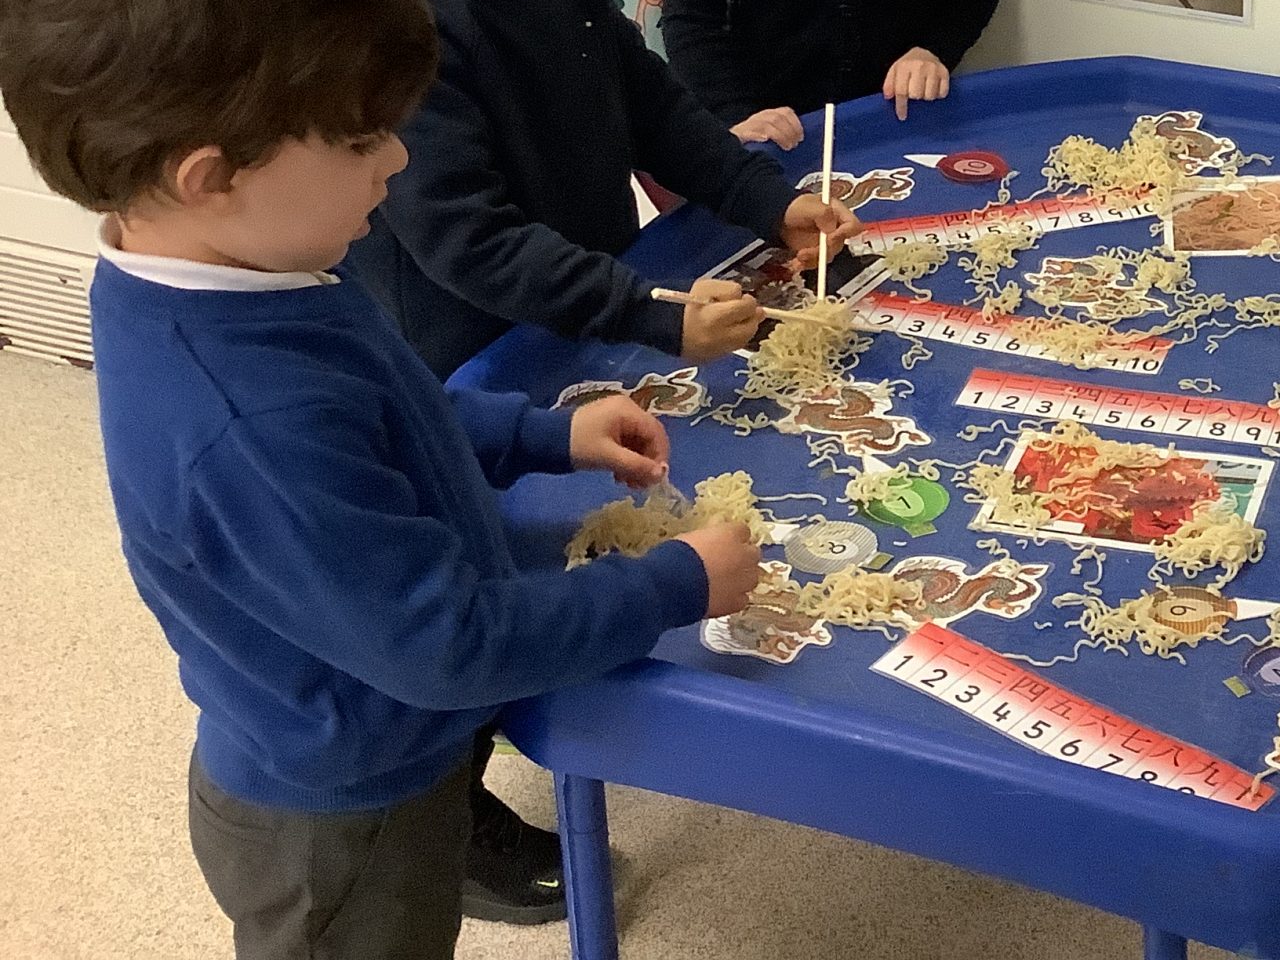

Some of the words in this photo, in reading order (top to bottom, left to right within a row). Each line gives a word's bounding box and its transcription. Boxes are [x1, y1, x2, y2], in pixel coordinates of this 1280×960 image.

[957, 231, 971, 241] 4
[1047, 216, 1061, 228] 7
[1078, 212, 1094, 223] 8
[908, 320, 925, 332] 3
[942, 325, 955, 339] 4
[972, 332, 990, 345] 5
[1006, 338, 1020, 351] 6
[1131, 358, 1160, 371] 10
[974, 391, 983, 404] 1
[1001, 395, 1020, 409] 2
[1036, 400, 1053, 413] 3
[1072, 405, 1086, 419] 4
[1105, 410, 1122, 423] 5
[1140, 415, 1155, 428] 6
[1176, 418, 1192, 431] 7
[1209, 422, 1226, 436] 8
[1246, 427, 1261, 441] 9
[894, 655, 913, 671] 1
[920, 668, 948, 688] 2
[955, 685, 981, 703] 3
[993, 702, 1011, 722] 4
[1023, 720, 1051, 739] 5
[1060, 739, 1083, 757] 6
[1100, 753, 1124, 770] 7
